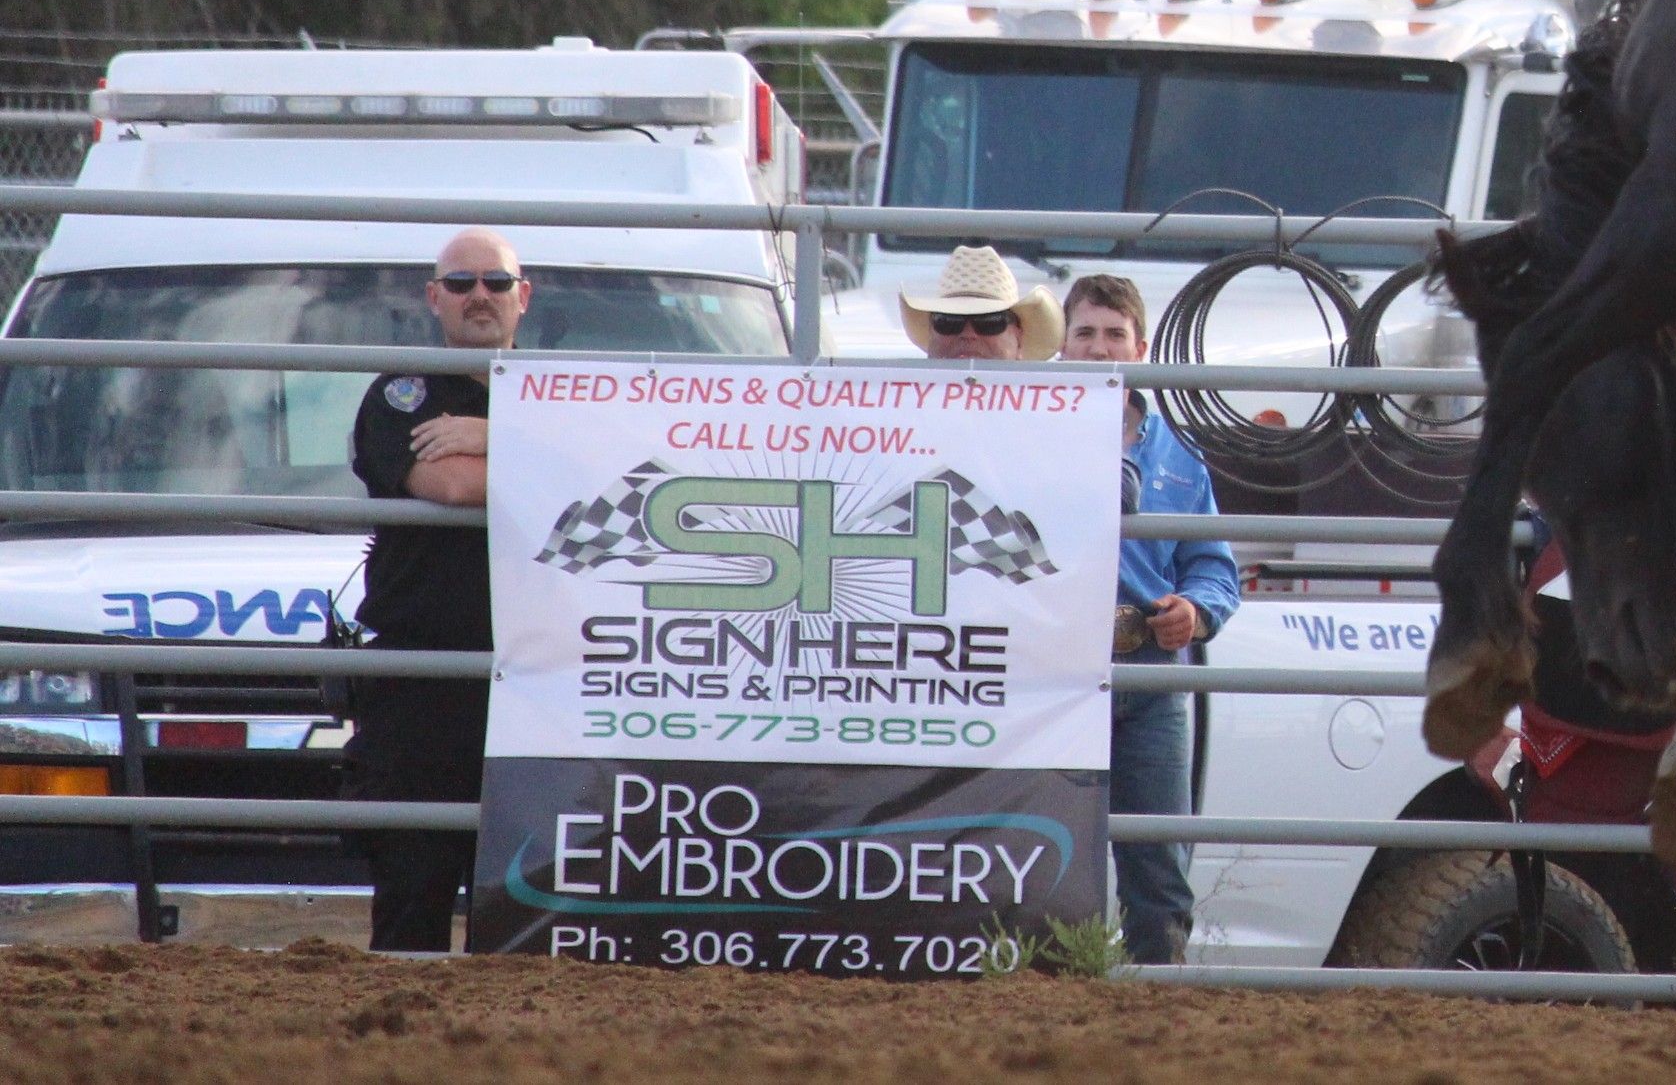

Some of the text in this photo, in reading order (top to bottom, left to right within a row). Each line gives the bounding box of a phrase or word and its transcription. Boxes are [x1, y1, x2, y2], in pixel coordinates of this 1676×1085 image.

[520, 374, 1086, 412] NEED SIGNS & QUALITY PRINTS?
[667, 422, 937, 455] CALL US NOW...
[642, 476, 950, 617] SH
[581, 616, 1009, 673] SIGN HERE
[1283, 616, 1426, 650] "We are
[580, 671, 1006, 707] SIGNS & PRINTING
[582, 711, 997, 748] 306-773-8850
[613, 774, 760, 836] PRO
[554, 814, 1045, 905] EMBROIDERY
[550, 925, 1021, 974] Ph: 306.773.7020
